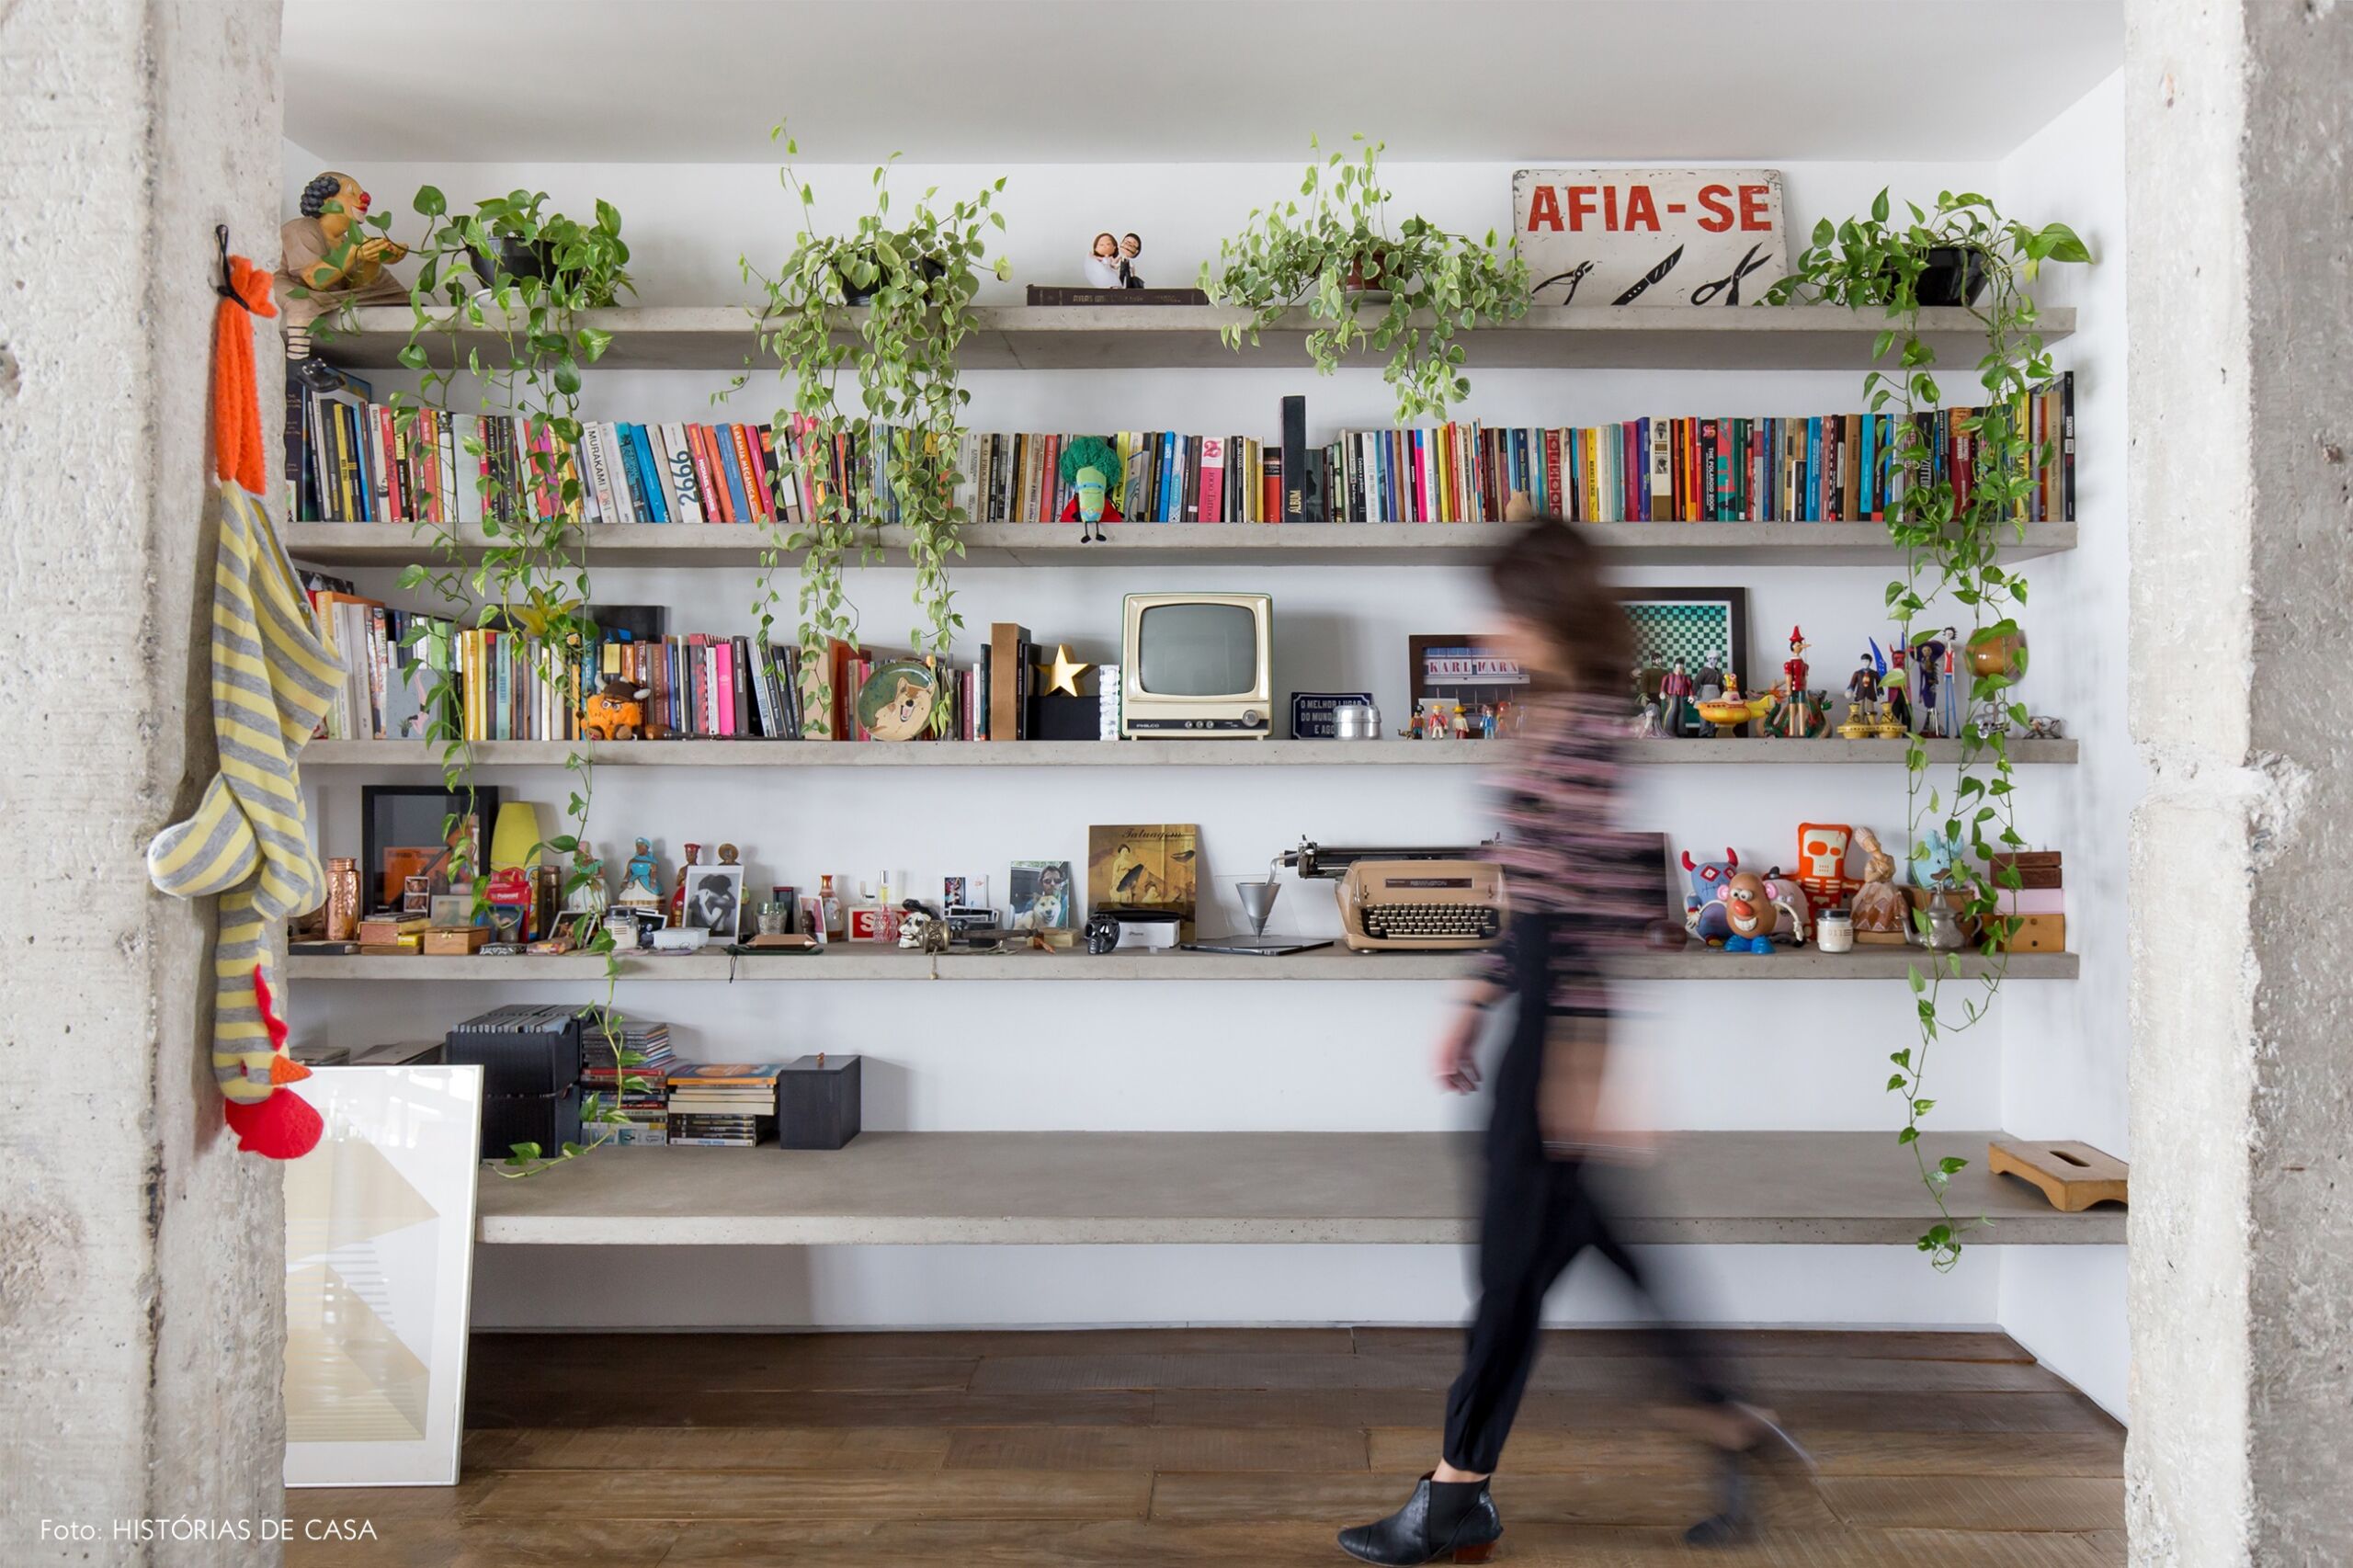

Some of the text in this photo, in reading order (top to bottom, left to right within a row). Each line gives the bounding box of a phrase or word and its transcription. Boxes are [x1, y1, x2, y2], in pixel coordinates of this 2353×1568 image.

[1527, 184, 1773, 233] AFIA-SE
[586, 429, 606, 485] MURAKAMI
[732, 425, 746, 459] LARANJA
[668, 449, 699, 506] 2666
[697, 458, 716, 512] MICHAEL MOORE
[1429, 661, 1472, 673] KARL
[1301, 699, 1306, 708] O
[1307, 699, 1336, 708] MELHOR
[1301, 711, 1334, 721] DO MUND
[1122, 828, 1183, 840] Tatuagem
